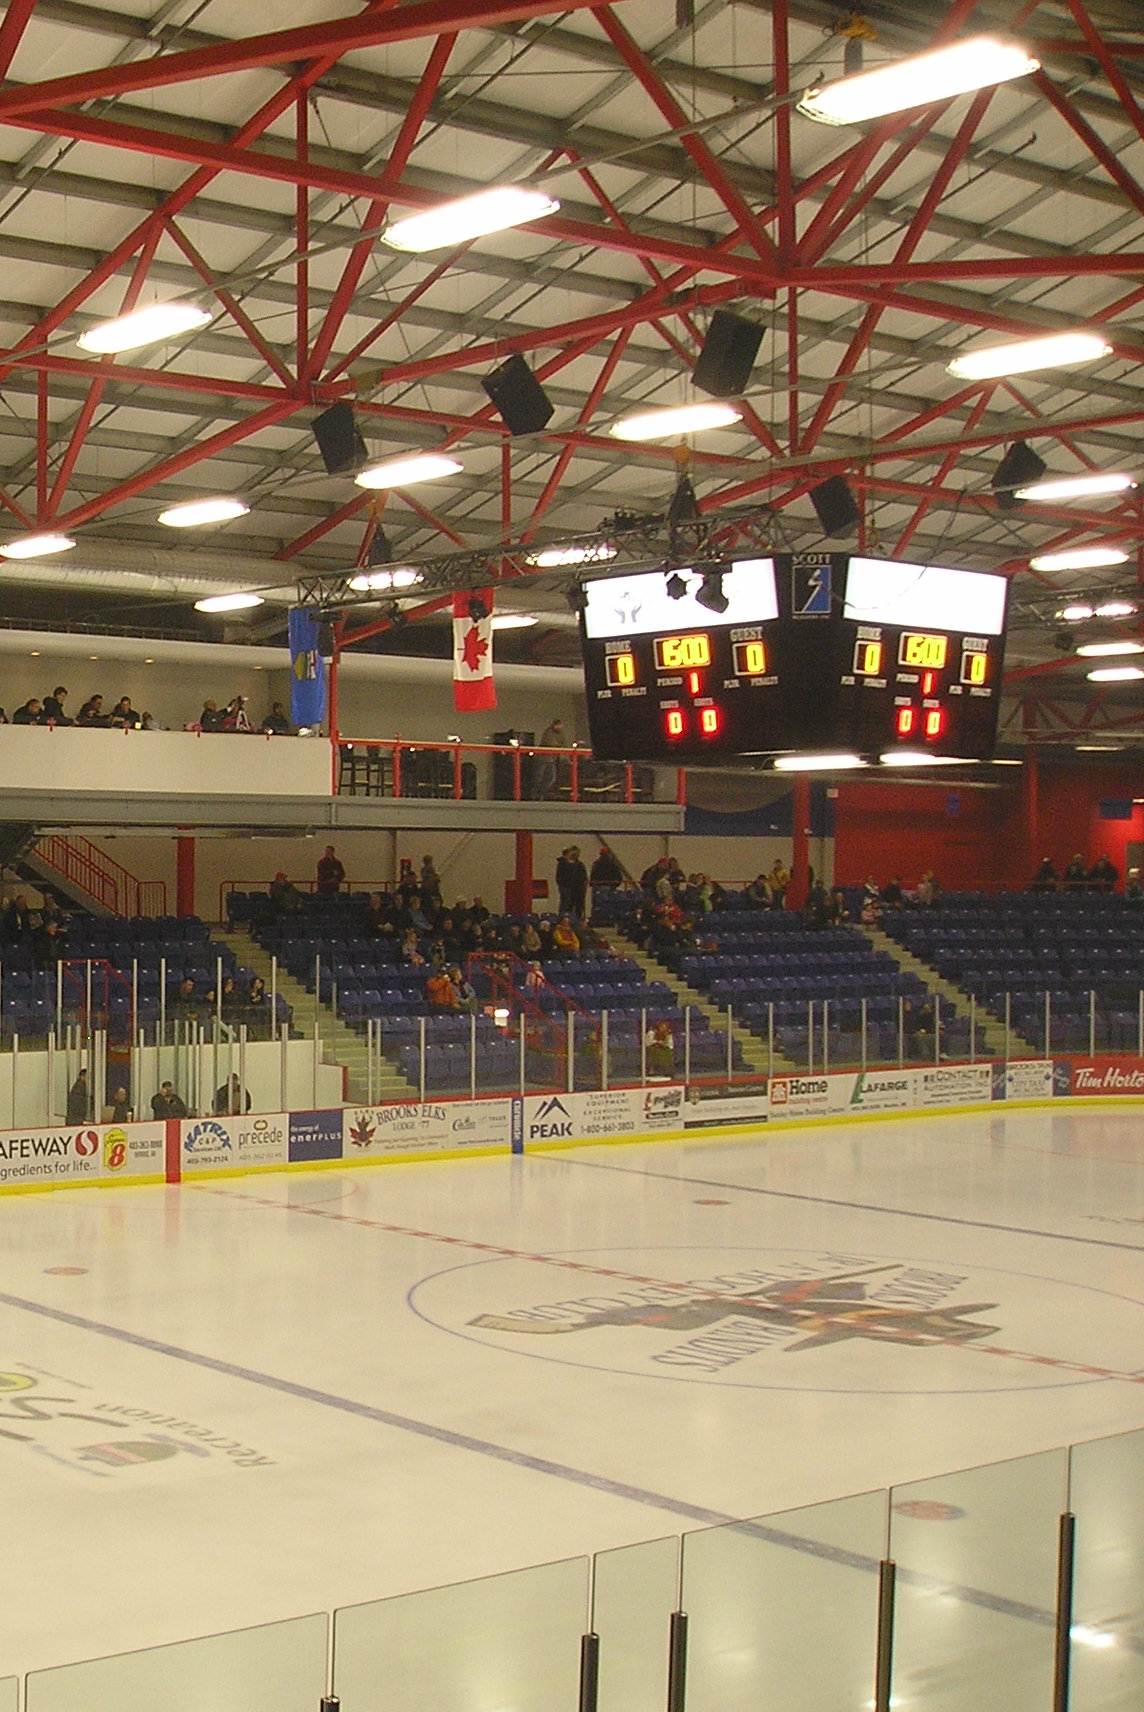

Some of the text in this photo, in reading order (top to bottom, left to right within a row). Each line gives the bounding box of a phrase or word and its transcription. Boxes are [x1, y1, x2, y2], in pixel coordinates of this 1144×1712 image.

[792, 553, 831, 564] SCOTT
[745, 643, 765, 674] 0
[864, 643, 881, 672] 0
[970, 654, 986, 682] 0
[617, 655, 635, 683] 0
[690, 672, 699, 694] 1
[923, 672, 933, 694] 1
[668, 711, 682, 735] 0
[702, 709, 717, 733] 0
[936, 1069, 979, 1082] CONTACT
[1075, 1067, 1102, 1088] Tim
[789, 1079, 828, 1096] Home
[860, 1080, 908, 1094] LAFARGE
[376, 1104, 447, 1125] BROOKS ELKS
[184, 1121, 233, 1152] MATRIX
[392, 1121, 415, 1131] LODGE
[530, 1122, 573, 1139] PEAK
[239, 1127, 283, 1149] precede
[108, 1144, 126, 1167] 8
[55, 1161, 71, 1174] for
[867, 1267, 970, 1311] BROOKS
[649, 1320, 799, 1373] BANDITS
[90, 1402, 278, 1469] Recreation
